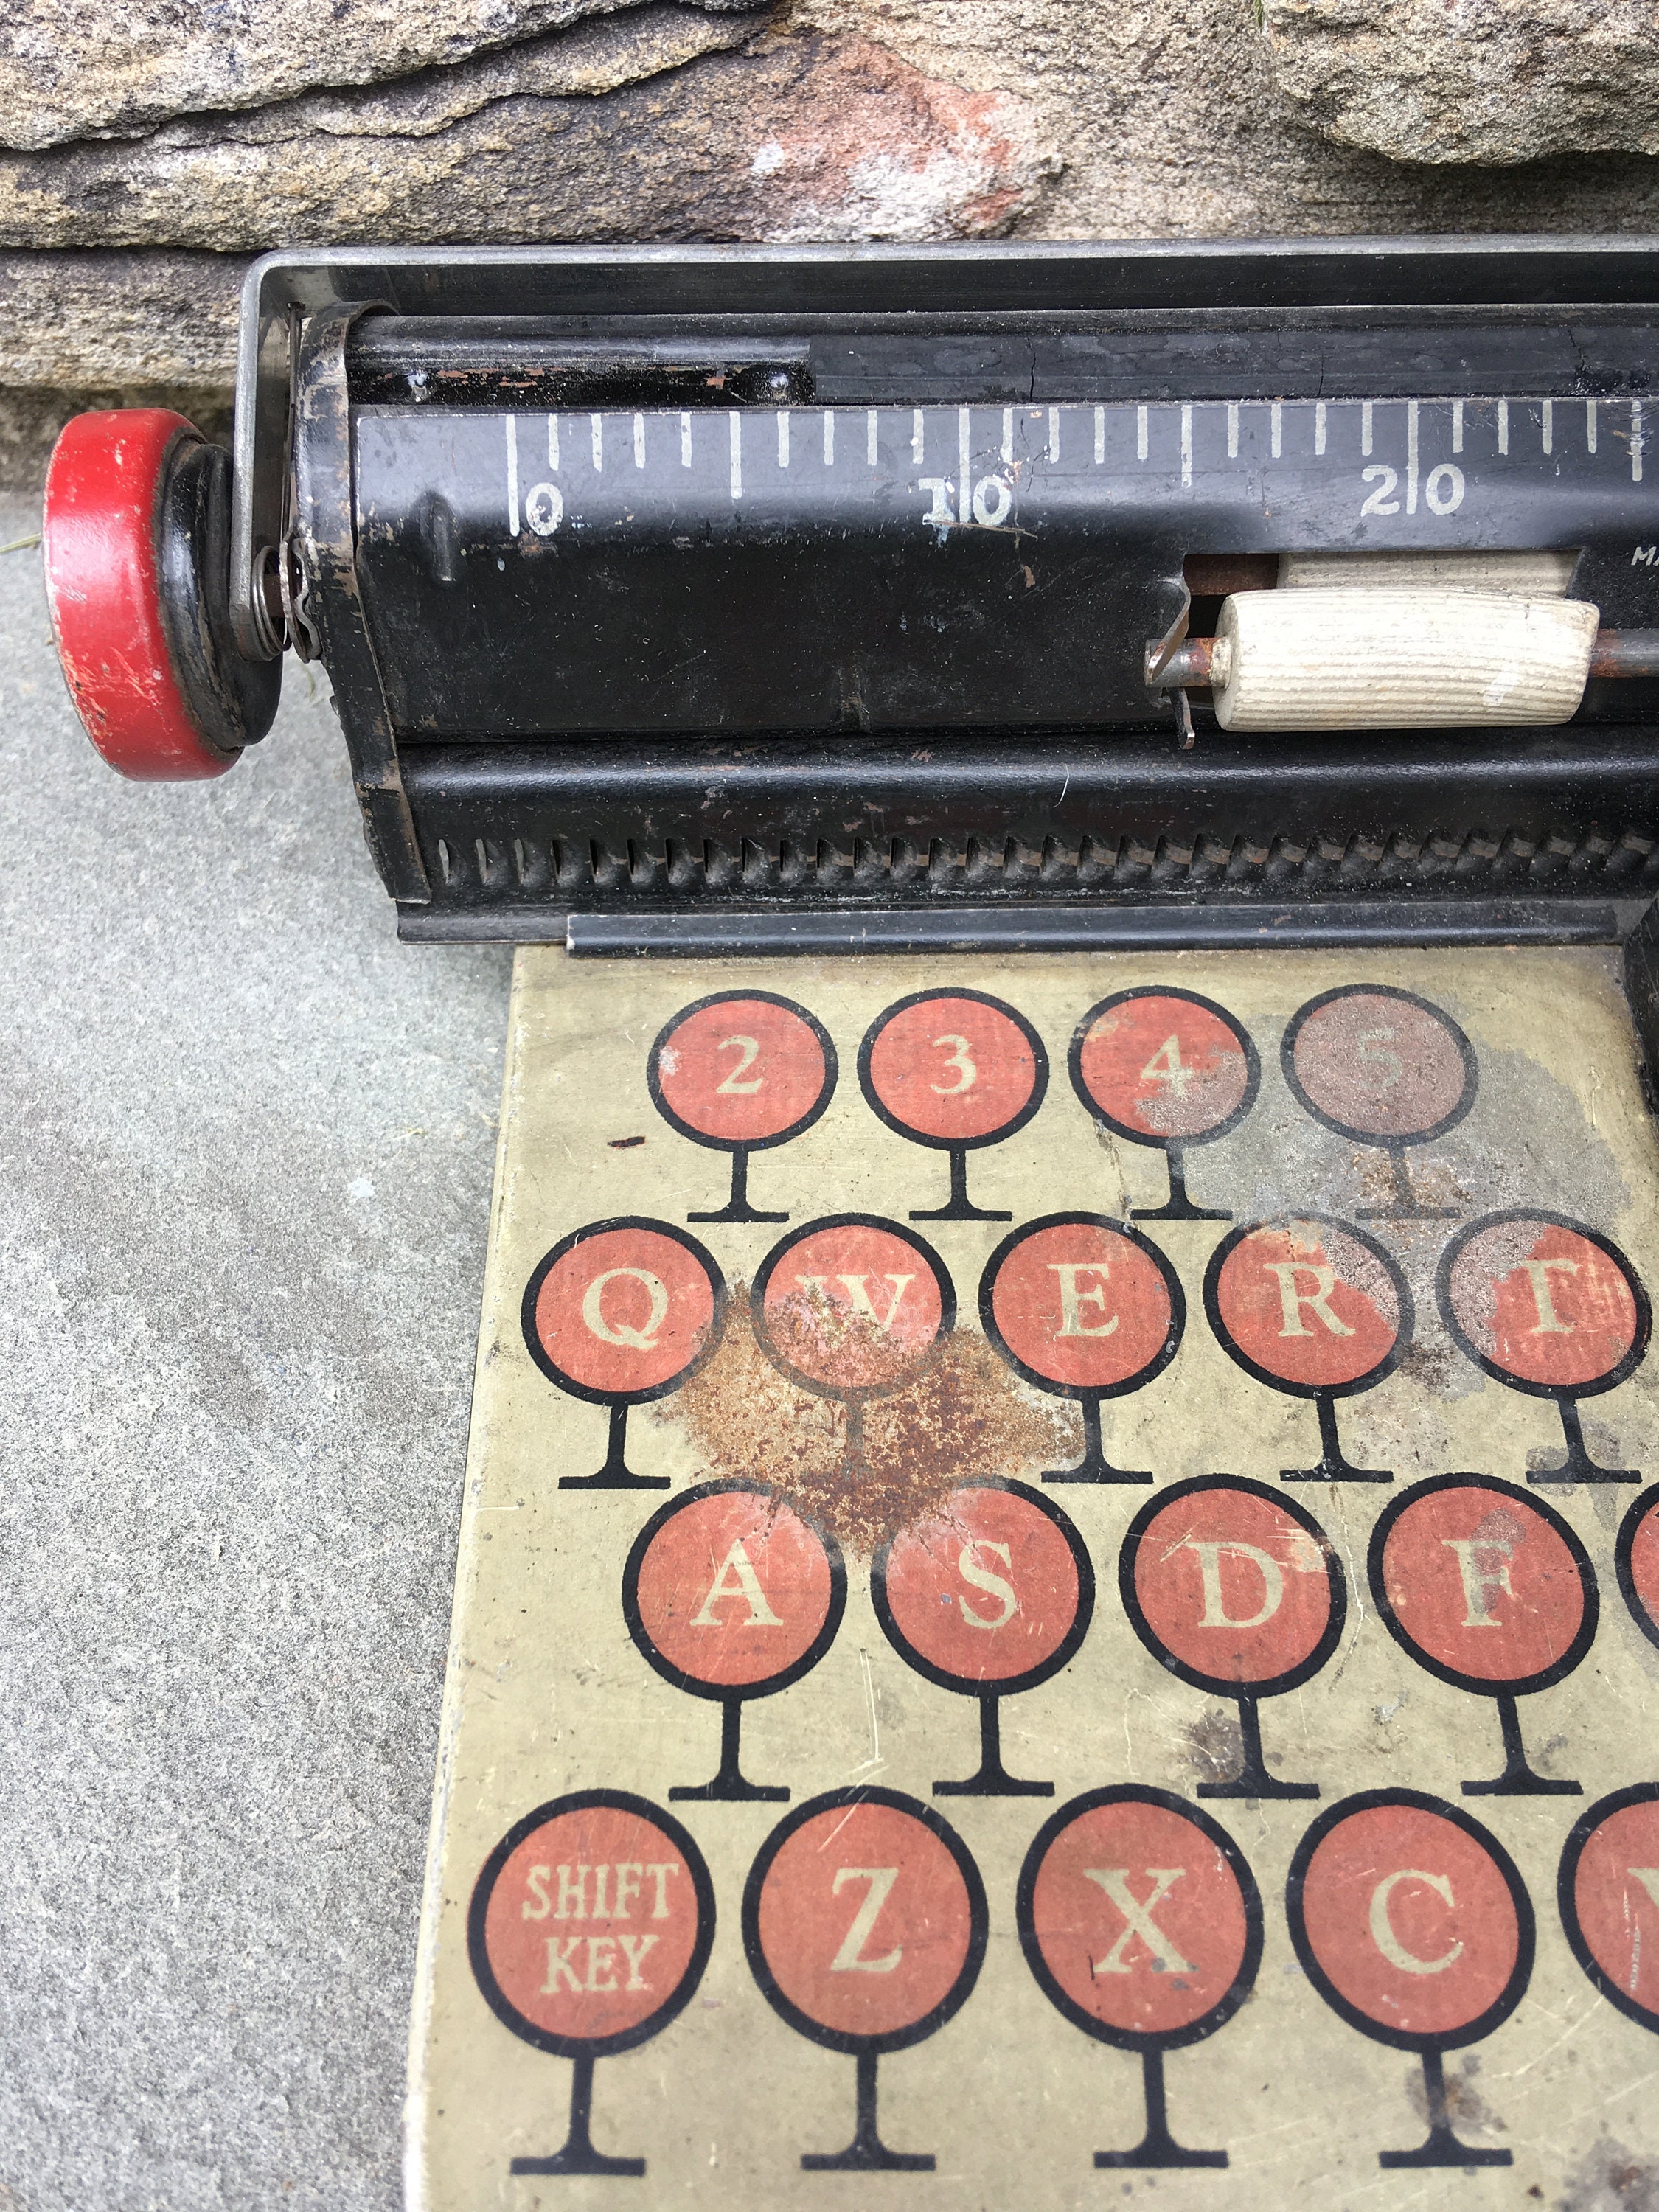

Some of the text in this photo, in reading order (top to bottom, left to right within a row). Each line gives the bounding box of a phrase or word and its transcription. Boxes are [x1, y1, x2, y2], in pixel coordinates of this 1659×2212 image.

[524, 482, 563, 537] 0
[1360, 463, 1465, 517] 20
[715, 1028, 1404, 1099] 2 3 4 5
[582, 1267, 669, 1350] Q
[1046, 1262, 1119, 1338] E
[1263, 1262, 1356, 1338] R
[1520, 1258, 1584, 1334] T
[689, 1538, 1515, 1630] A S D F
[521, 1862, 681, 1921] SHIFT
[830, 1866, 1465, 1975] Z X C
[540, 1933, 660, 1996] KEY
